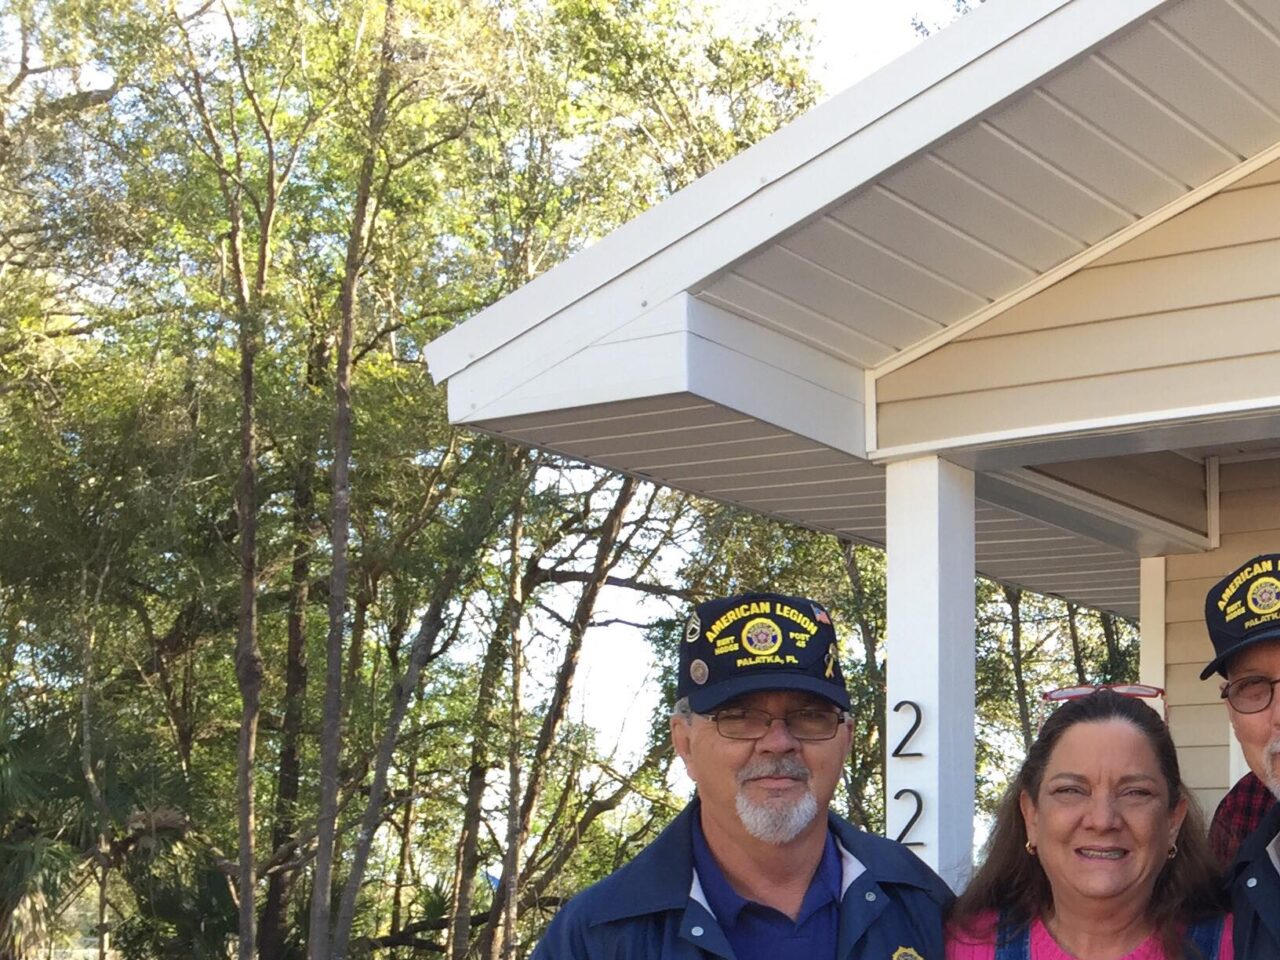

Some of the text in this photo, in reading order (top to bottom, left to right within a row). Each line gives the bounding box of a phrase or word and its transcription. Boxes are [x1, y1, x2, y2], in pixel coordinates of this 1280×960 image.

[1218, 560, 1273, 611] AMERICAN
[705, 602, 771, 643] AMERICAN
[775, 603, 818, 635] LEGION
